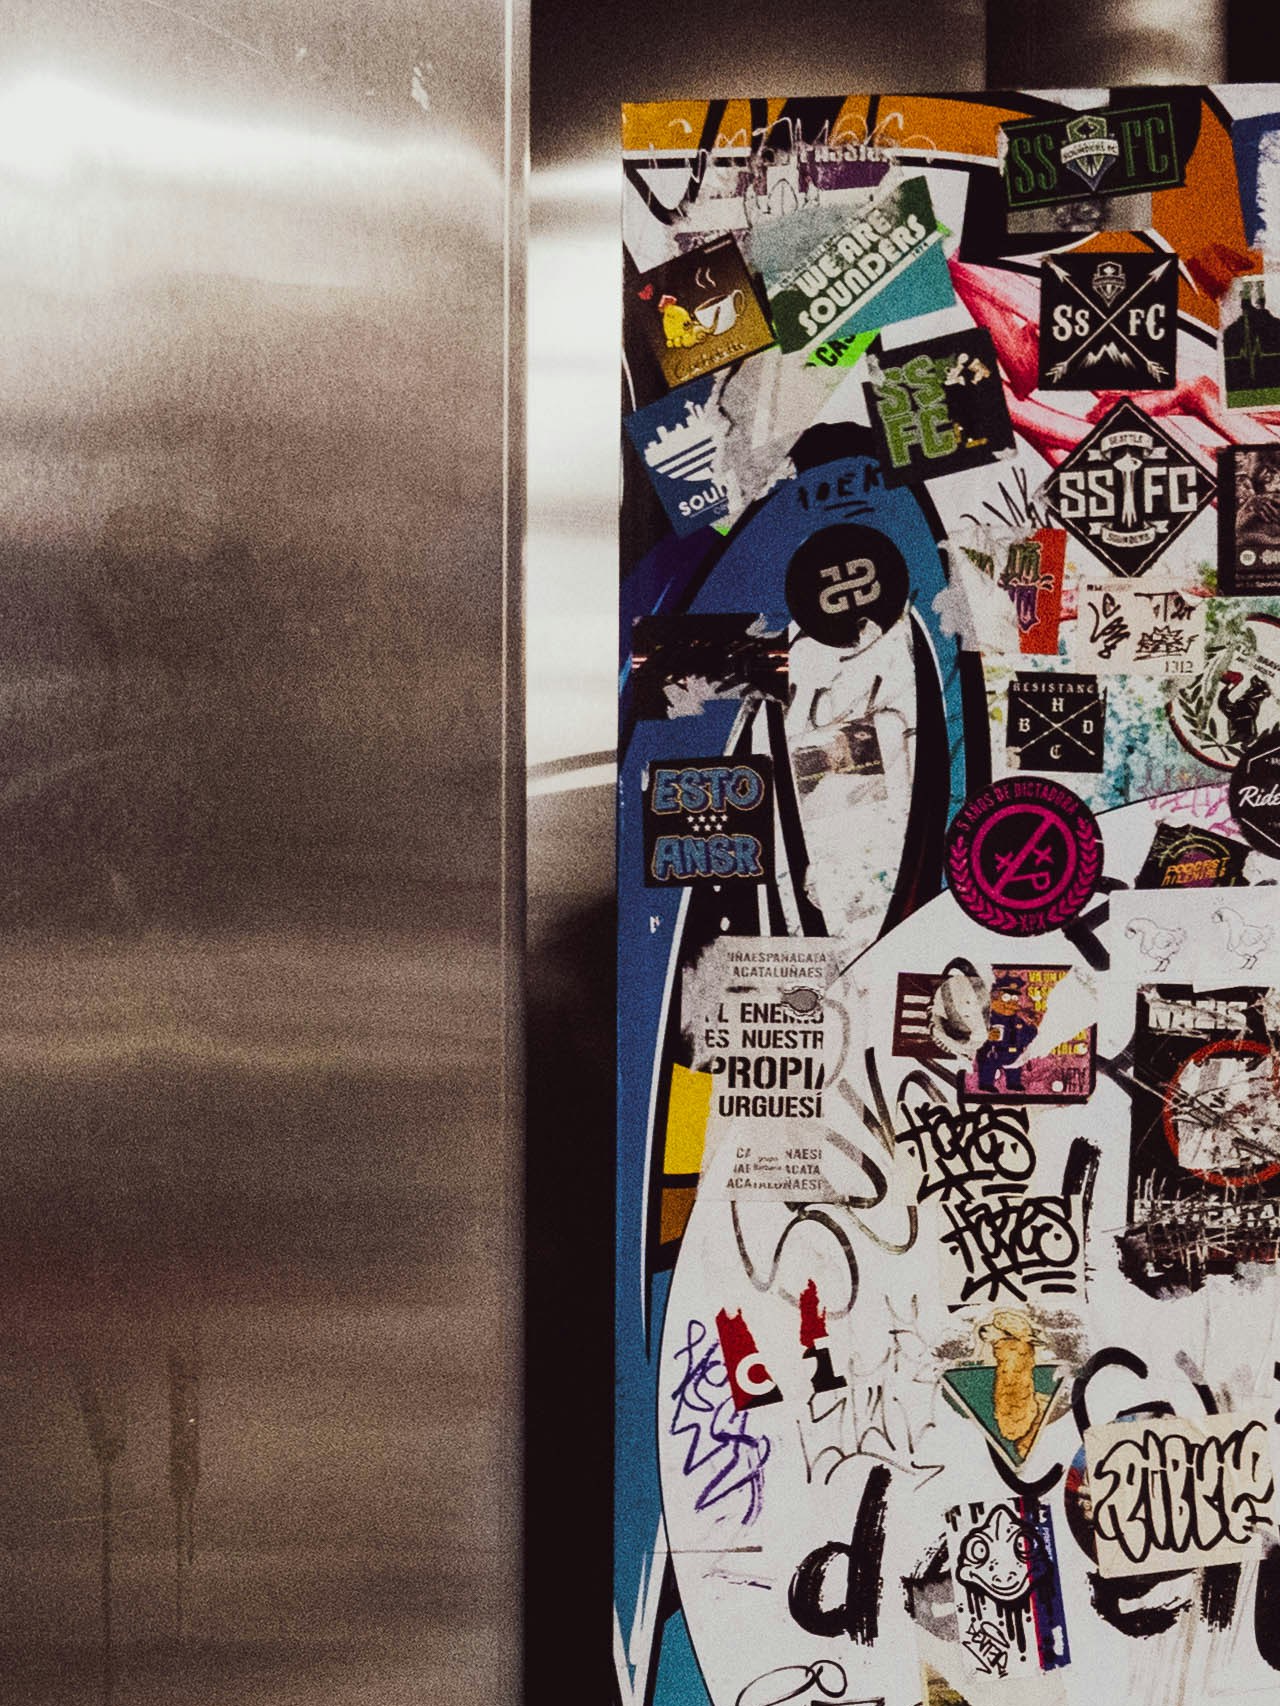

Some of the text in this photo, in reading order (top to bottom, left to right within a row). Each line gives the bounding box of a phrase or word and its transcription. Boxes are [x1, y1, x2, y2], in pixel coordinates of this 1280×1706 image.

[1121, 117, 1168, 177] FC
[796, 254, 843, 299] WE
[844, 208, 893, 263] ARE
[799, 213, 926, 337] SOUNDERS
[1129, 304, 1165, 340] FC
[1108, 432, 1144, 449] SEATTLE
[1060, 467, 1197, 518] SS FC
[653, 766, 765, 816] ESTO
